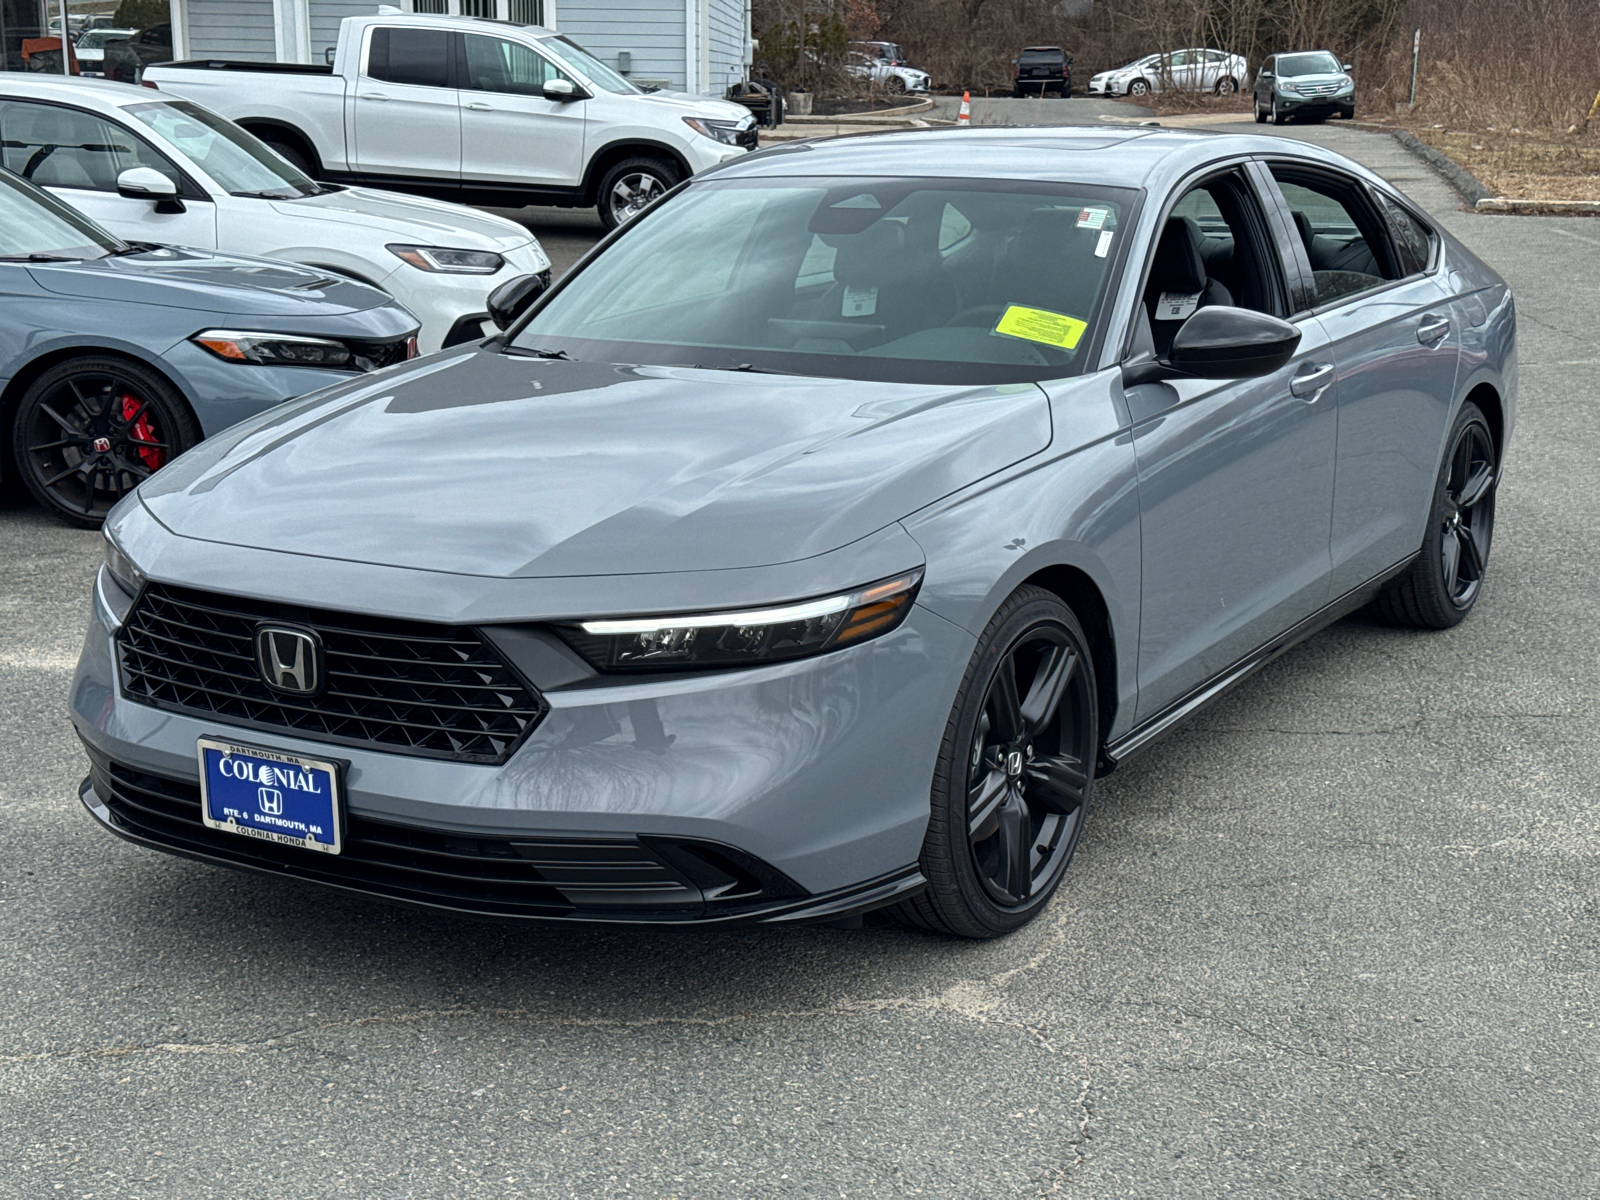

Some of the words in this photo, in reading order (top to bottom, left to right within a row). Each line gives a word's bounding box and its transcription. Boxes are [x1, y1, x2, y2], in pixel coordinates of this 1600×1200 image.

[219, 758, 321, 793] COLONIAL
[223, 807, 241, 818] RTE.
[254, 814, 308, 832] DARTMOUTH,
[309, 825, 323, 834] MA
[236, 826, 275, 841] COLONIAL
[277, 835, 306, 847] HONDA
